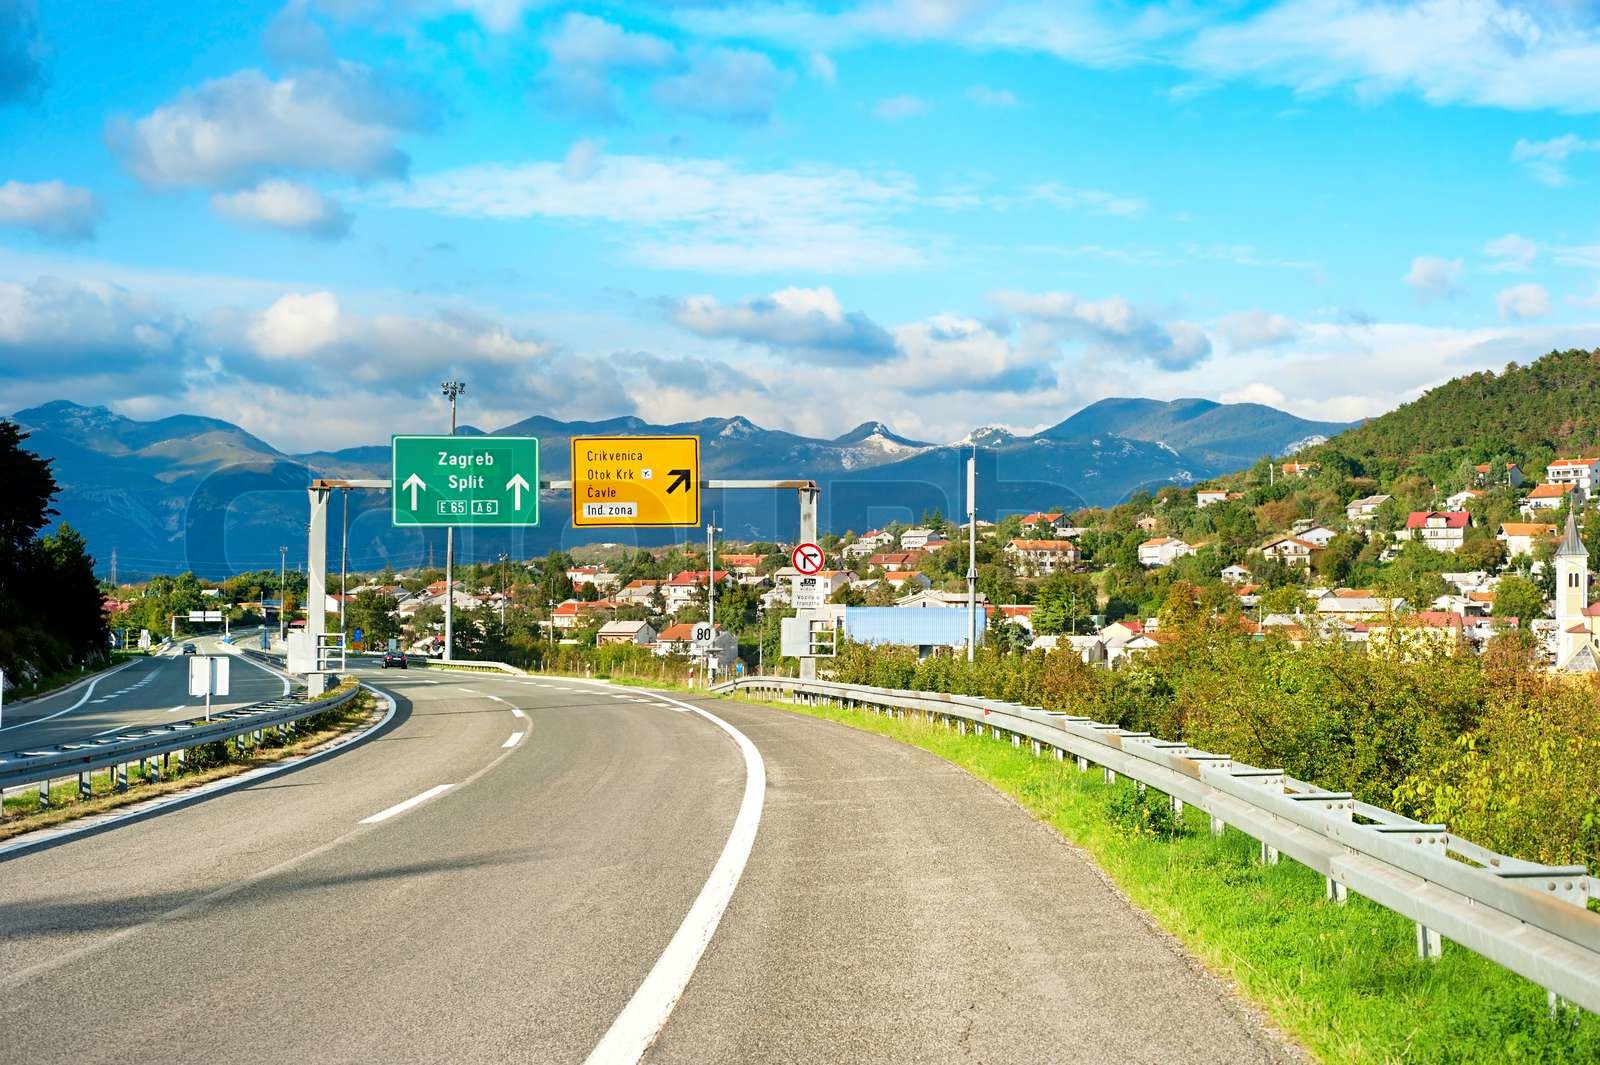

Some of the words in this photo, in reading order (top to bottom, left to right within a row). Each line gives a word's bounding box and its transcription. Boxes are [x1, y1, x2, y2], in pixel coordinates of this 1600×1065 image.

[438, 451, 494, 469] Zagreb
[587, 450, 643, 462] Crikvenica
[587, 469, 611, 480] Otok
[616, 469, 634, 480] Krk
[448, 474, 485, 492] Split
[587, 484, 616, 498] Čavle
[440, 501, 447, 513] E
[450, 501, 465, 513] 65
[477, 502, 483, 513] A
[486, 502, 492, 513] 6
[587, 504, 606, 516] Ind.
[608, 506, 633, 516] zona
[696, 628, 711, 641] 80
